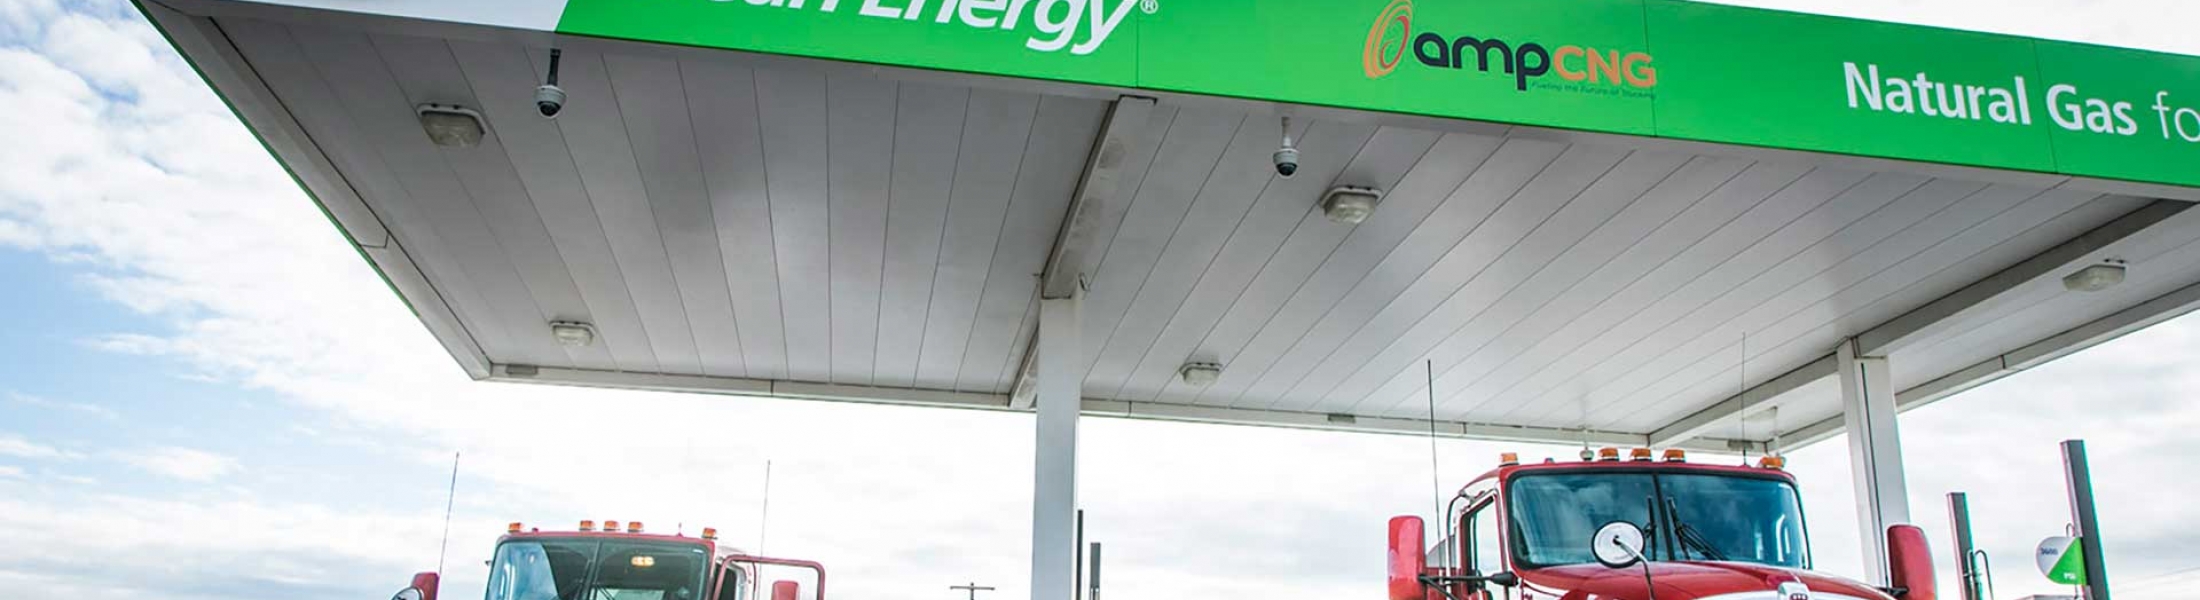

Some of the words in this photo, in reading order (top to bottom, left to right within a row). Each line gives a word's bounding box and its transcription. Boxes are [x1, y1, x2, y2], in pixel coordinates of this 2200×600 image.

[1413, 32, 1657, 91] ampCNG
[1843, 61, 2032, 125] Natural
[2046, 84, 2137, 136] Gas
